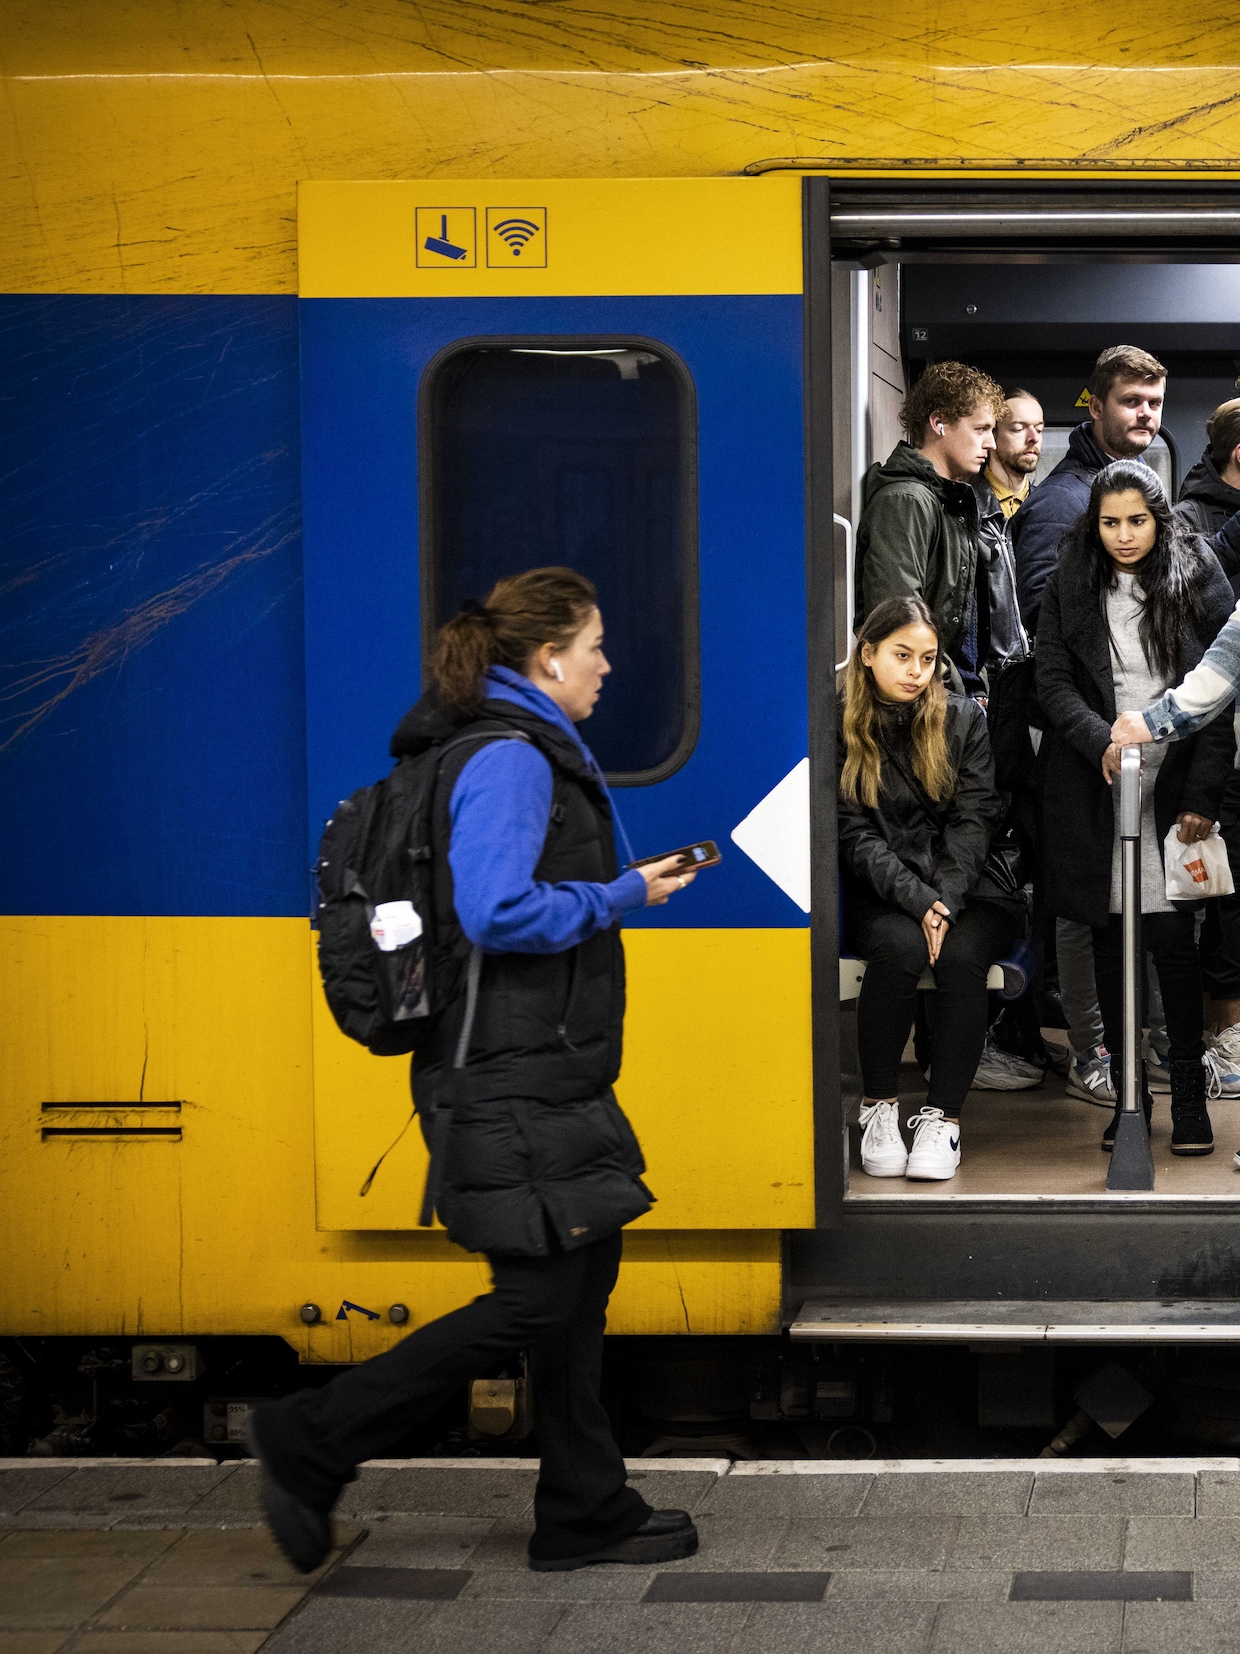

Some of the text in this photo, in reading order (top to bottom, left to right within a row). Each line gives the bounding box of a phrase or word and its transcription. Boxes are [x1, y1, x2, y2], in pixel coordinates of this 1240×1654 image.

[915, 331, 927, 339] 12
[1190, 866, 1206, 877] EMA
[1083, 1070, 1107, 1091] N
